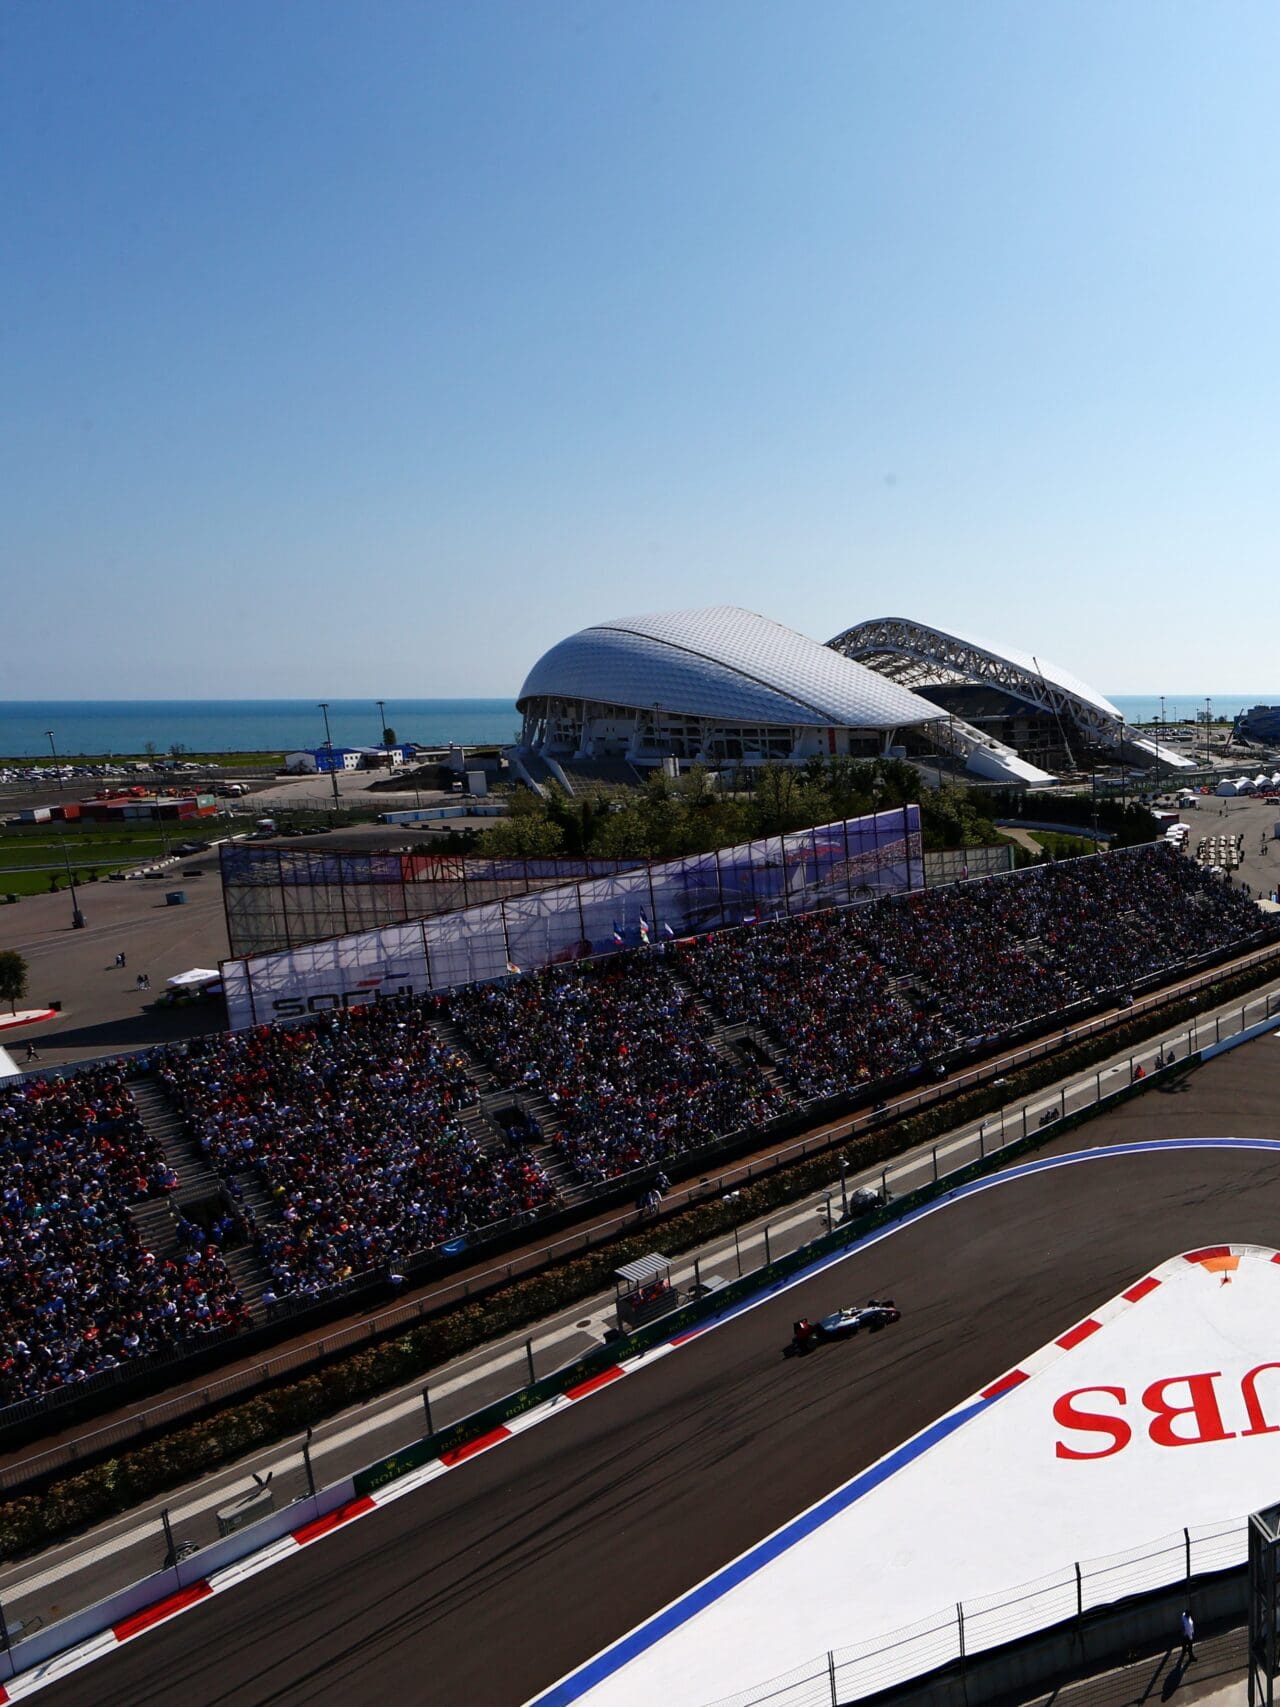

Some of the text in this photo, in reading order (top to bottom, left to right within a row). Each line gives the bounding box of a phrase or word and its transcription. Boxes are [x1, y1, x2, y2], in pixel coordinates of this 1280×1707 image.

[504, 1393, 545, 1418] ROLEX
[440, 1425, 482, 1451] ROLEX
[370, 1460, 415, 1488] ROLEX
